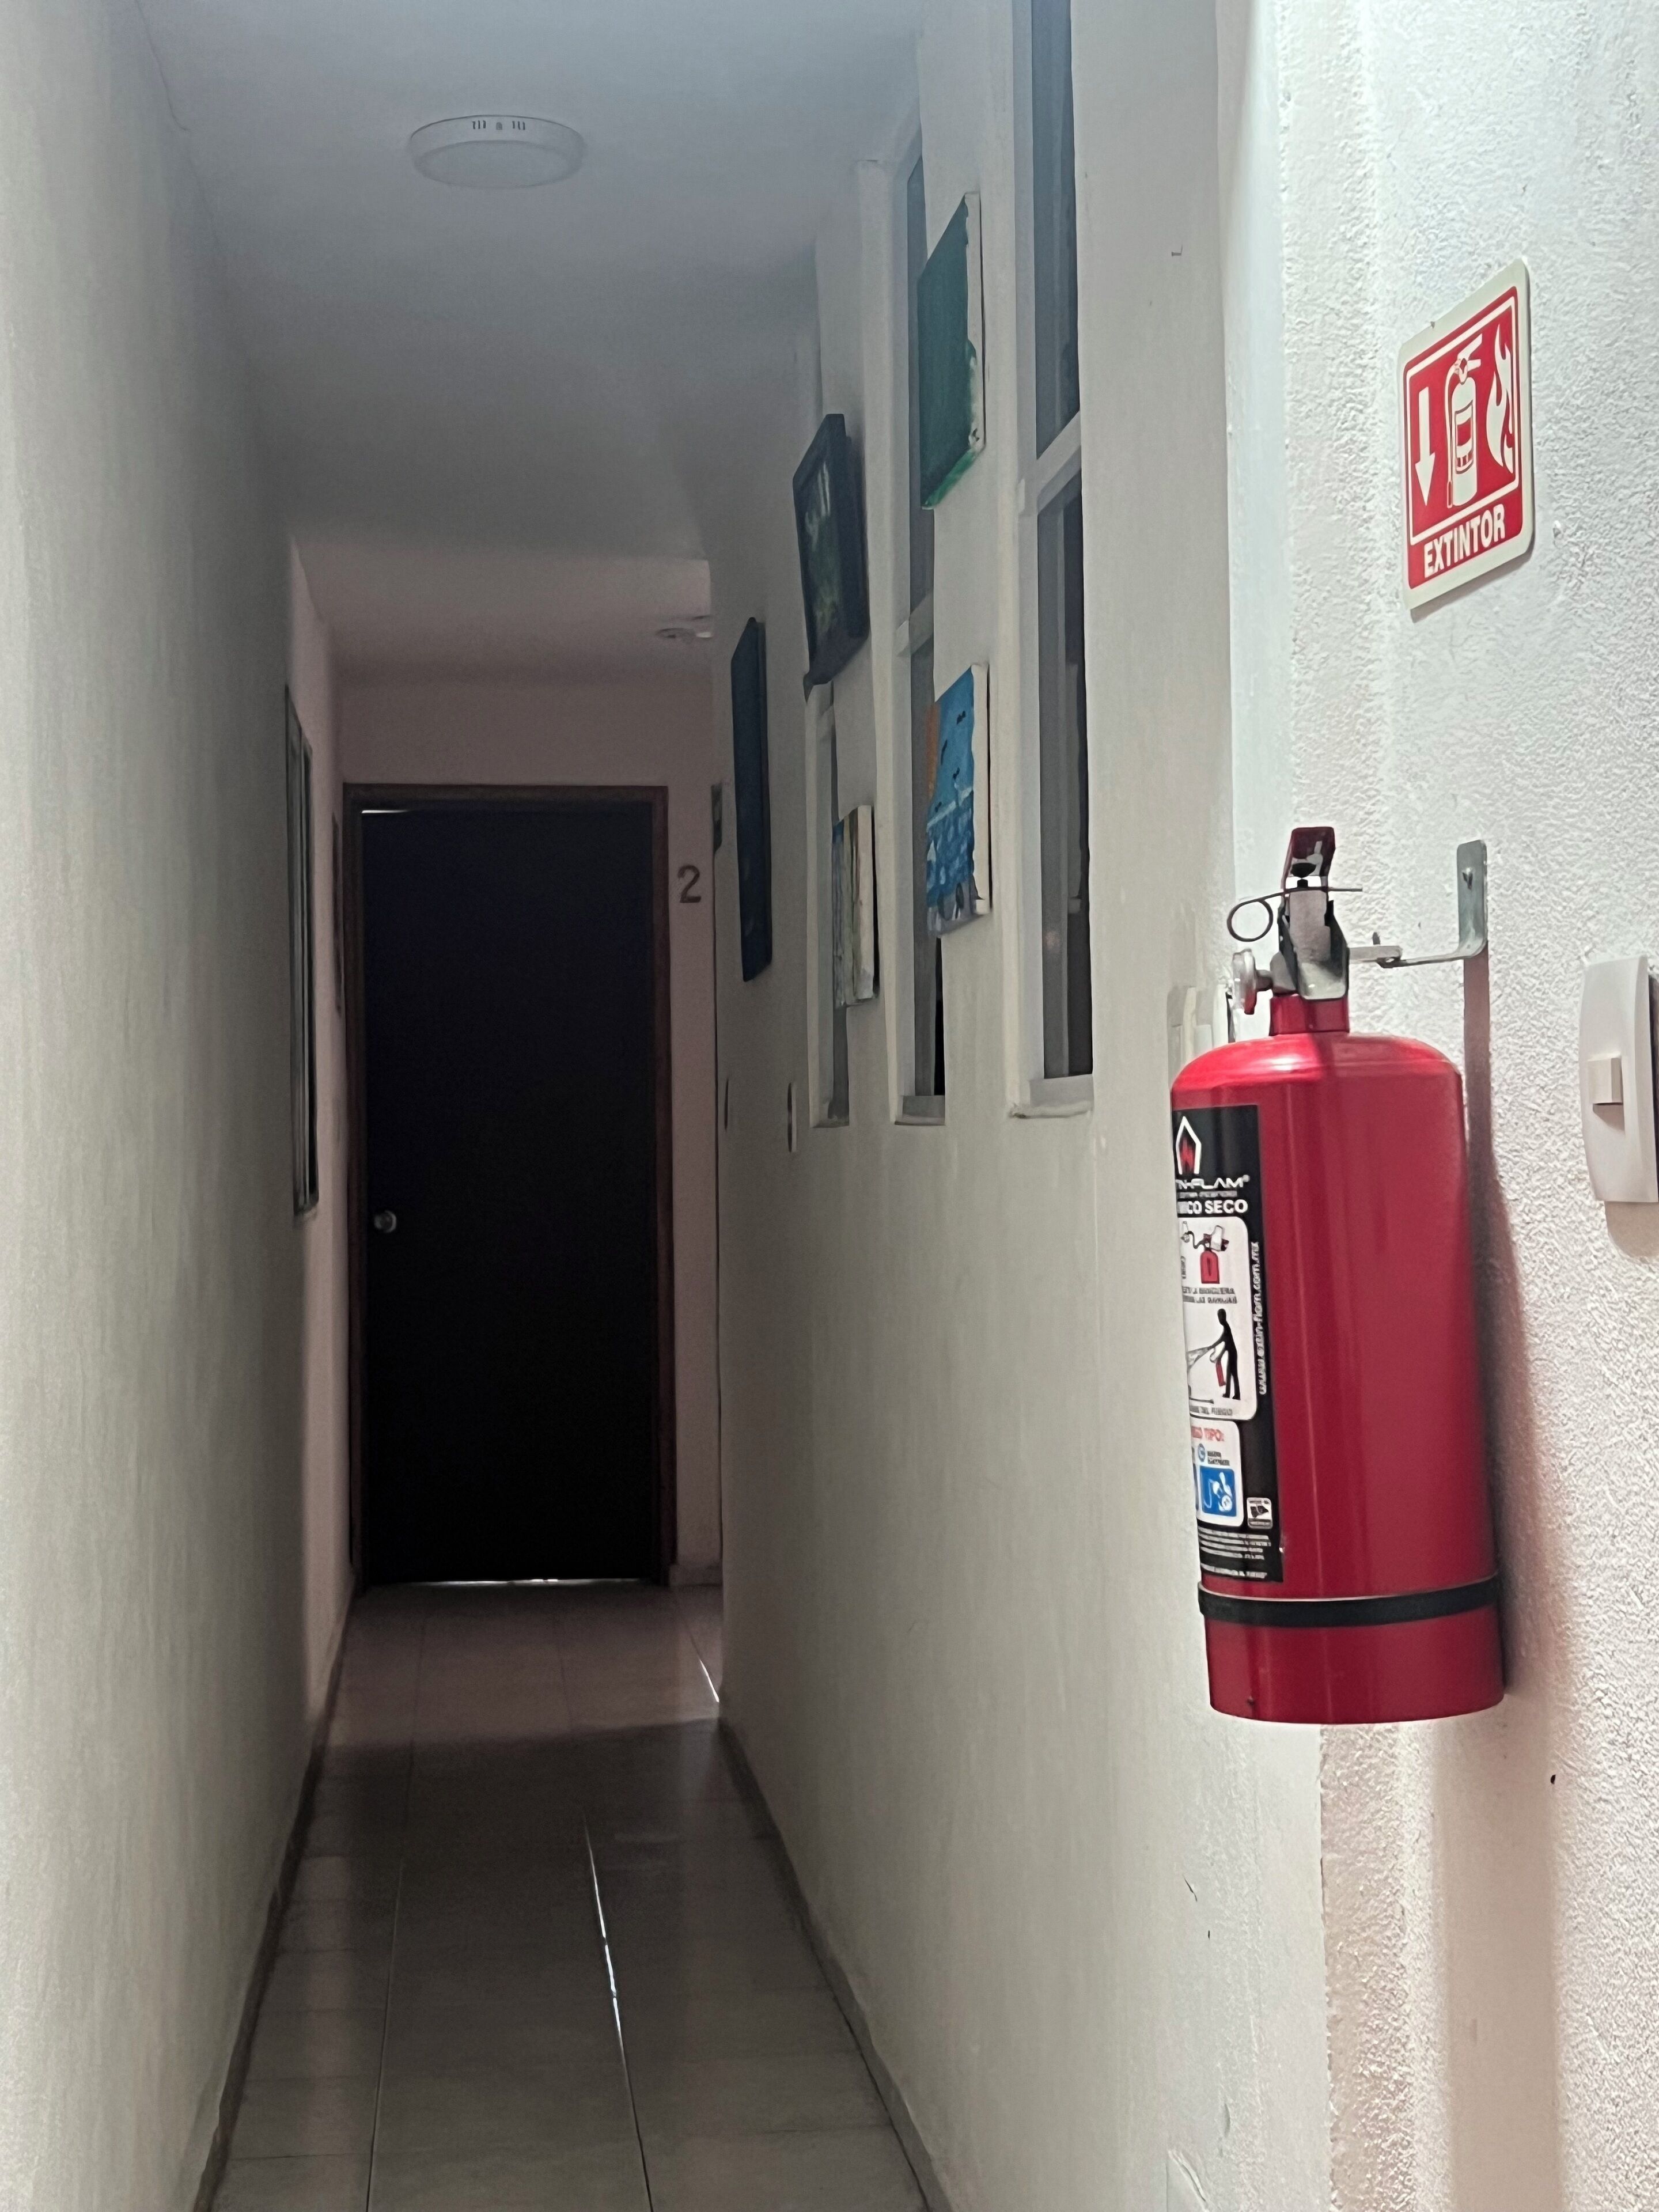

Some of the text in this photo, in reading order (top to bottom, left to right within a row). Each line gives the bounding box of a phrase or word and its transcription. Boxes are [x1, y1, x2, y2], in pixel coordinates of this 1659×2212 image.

[1424, 503, 1505, 578] EXTINTOR
[677, 865, 702, 903] 2
[1205, 1199, 1248, 1214] SECO
